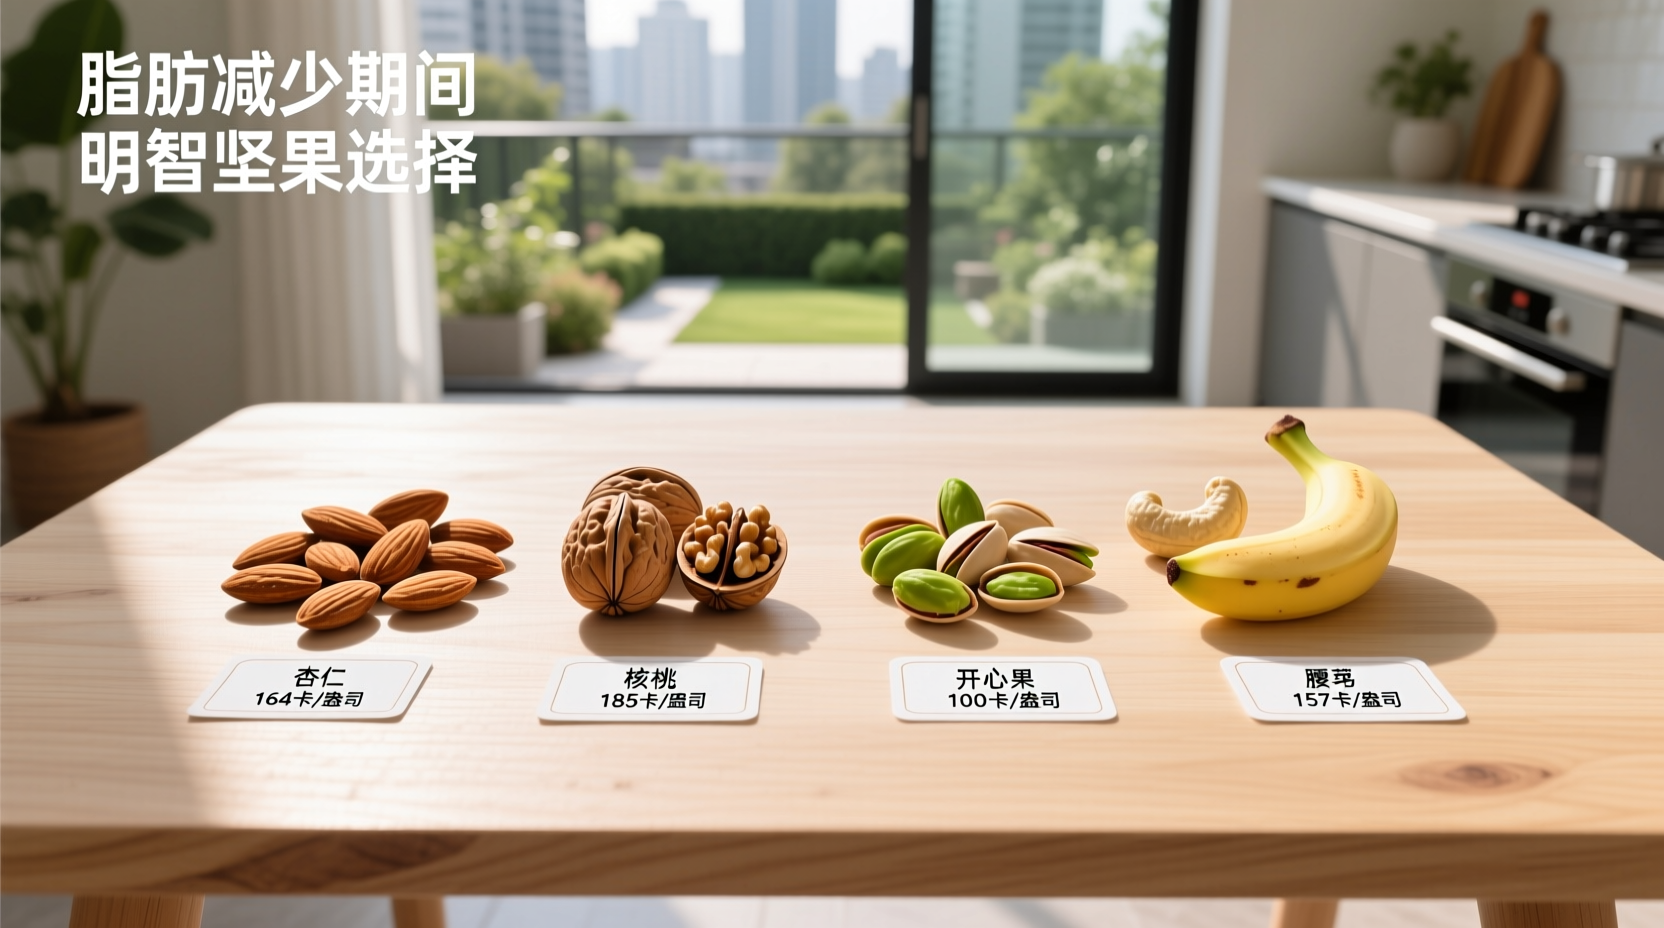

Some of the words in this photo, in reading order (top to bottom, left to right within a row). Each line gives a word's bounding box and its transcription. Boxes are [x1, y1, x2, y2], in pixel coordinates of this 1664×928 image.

[294, 665, 346, 688] 杏仁
[623, 666, 677, 690] 核桃
[956, 667, 1035, 690] 开心果
[948, 691, 1060, 710] 100卡/盎司
[1293, 691, 1402, 709] 157卡/盎司
